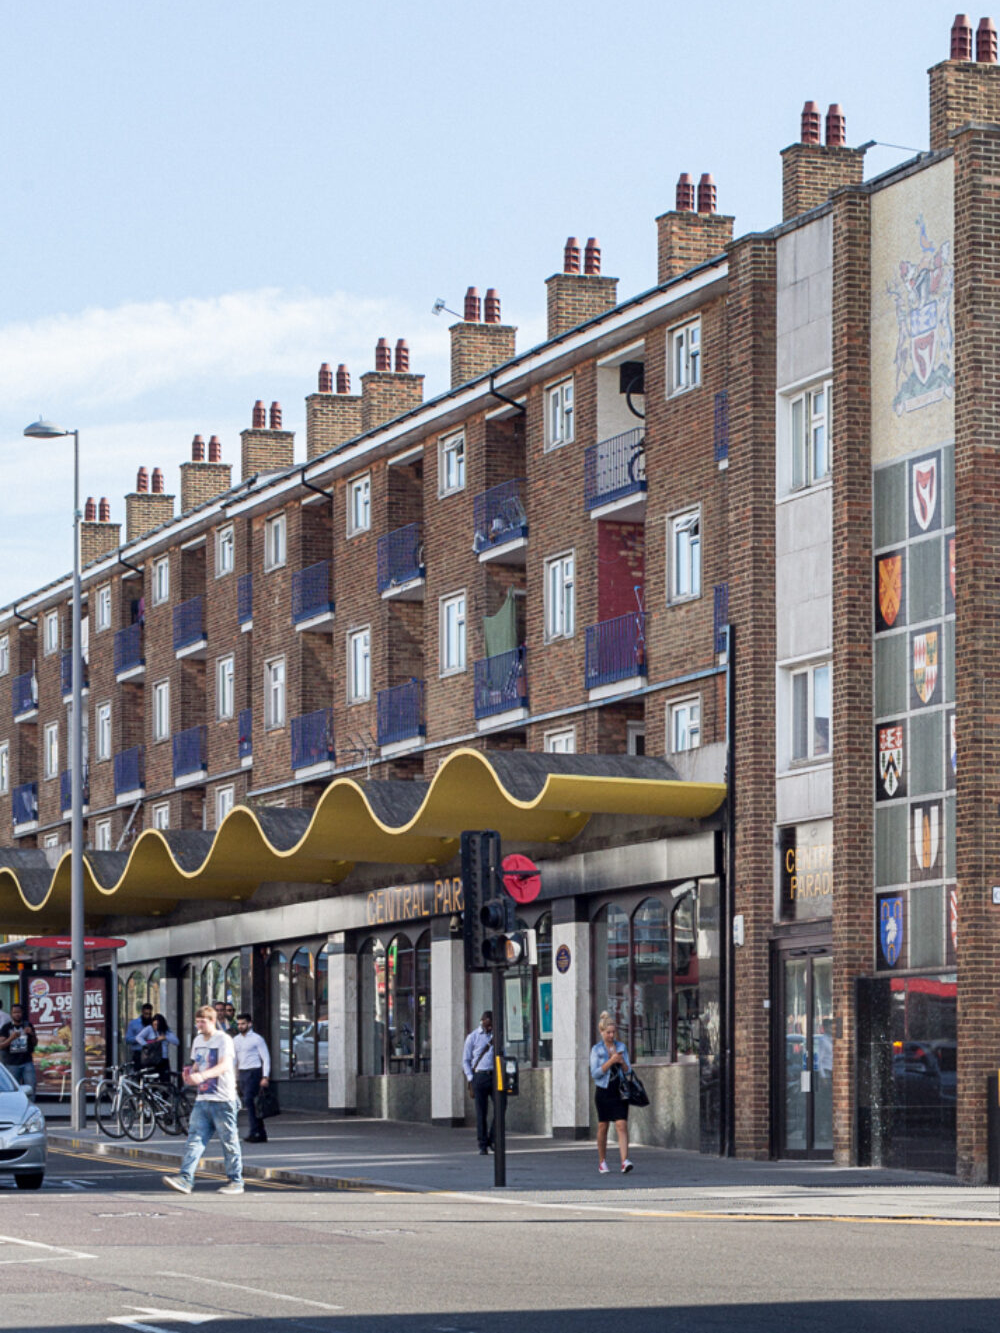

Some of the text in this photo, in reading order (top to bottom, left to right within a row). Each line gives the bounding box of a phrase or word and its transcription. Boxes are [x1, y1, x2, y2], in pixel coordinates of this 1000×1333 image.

[786, 844, 833, 873] CENTRA
[790, 872, 833, 900] PARAD
[367, 884, 430, 926] CENTRAL
[30, 996, 72, 1022] £2.99
